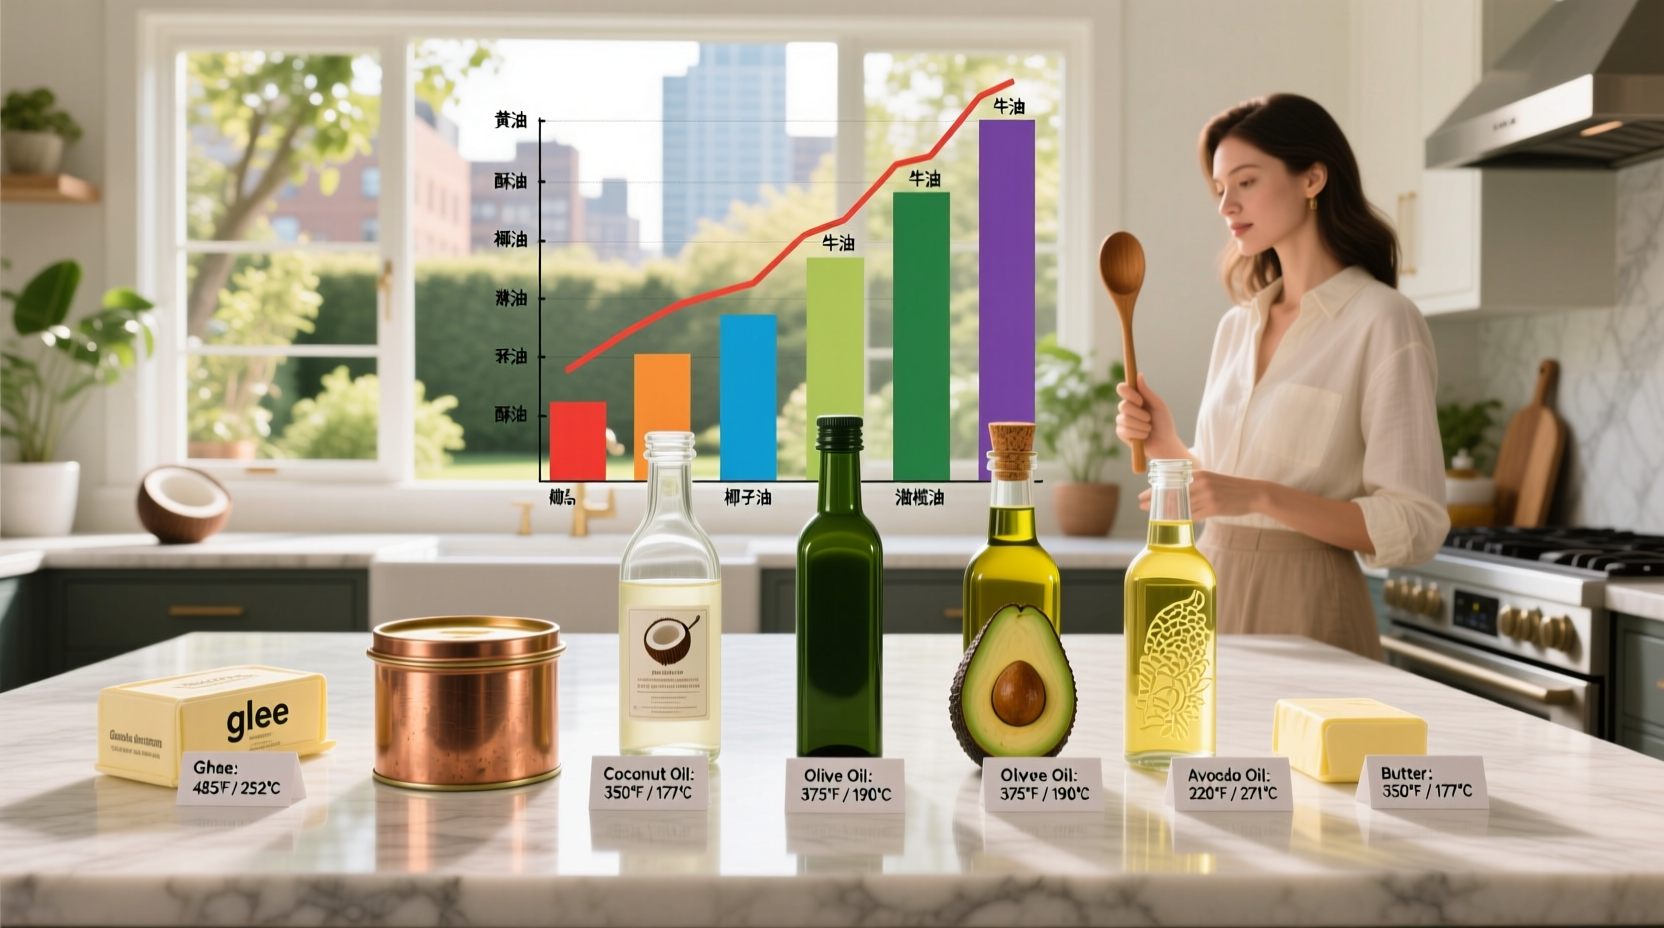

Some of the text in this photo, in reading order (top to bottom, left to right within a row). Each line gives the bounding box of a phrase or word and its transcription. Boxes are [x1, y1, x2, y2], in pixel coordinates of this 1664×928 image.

[226, 698, 289, 744] glee
[603, 766, 667, 781] Coconut
[804, 767, 873, 783] Olive Oil:
[1051, 767, 1078, 783] Oil:
[1245, 767, 1271, 783] Oil:
[1381, 766, 1433, 781] Butter:
[646, 785, 654, 802] /
[800, 787, 892, 803] 375°F / 190°C
[1000, 786, 1090, 803] 375°F / 190°C
[1188, 785, 1278, 802] 220°F / 271°C
[1425, 783, 1432, 800] /
